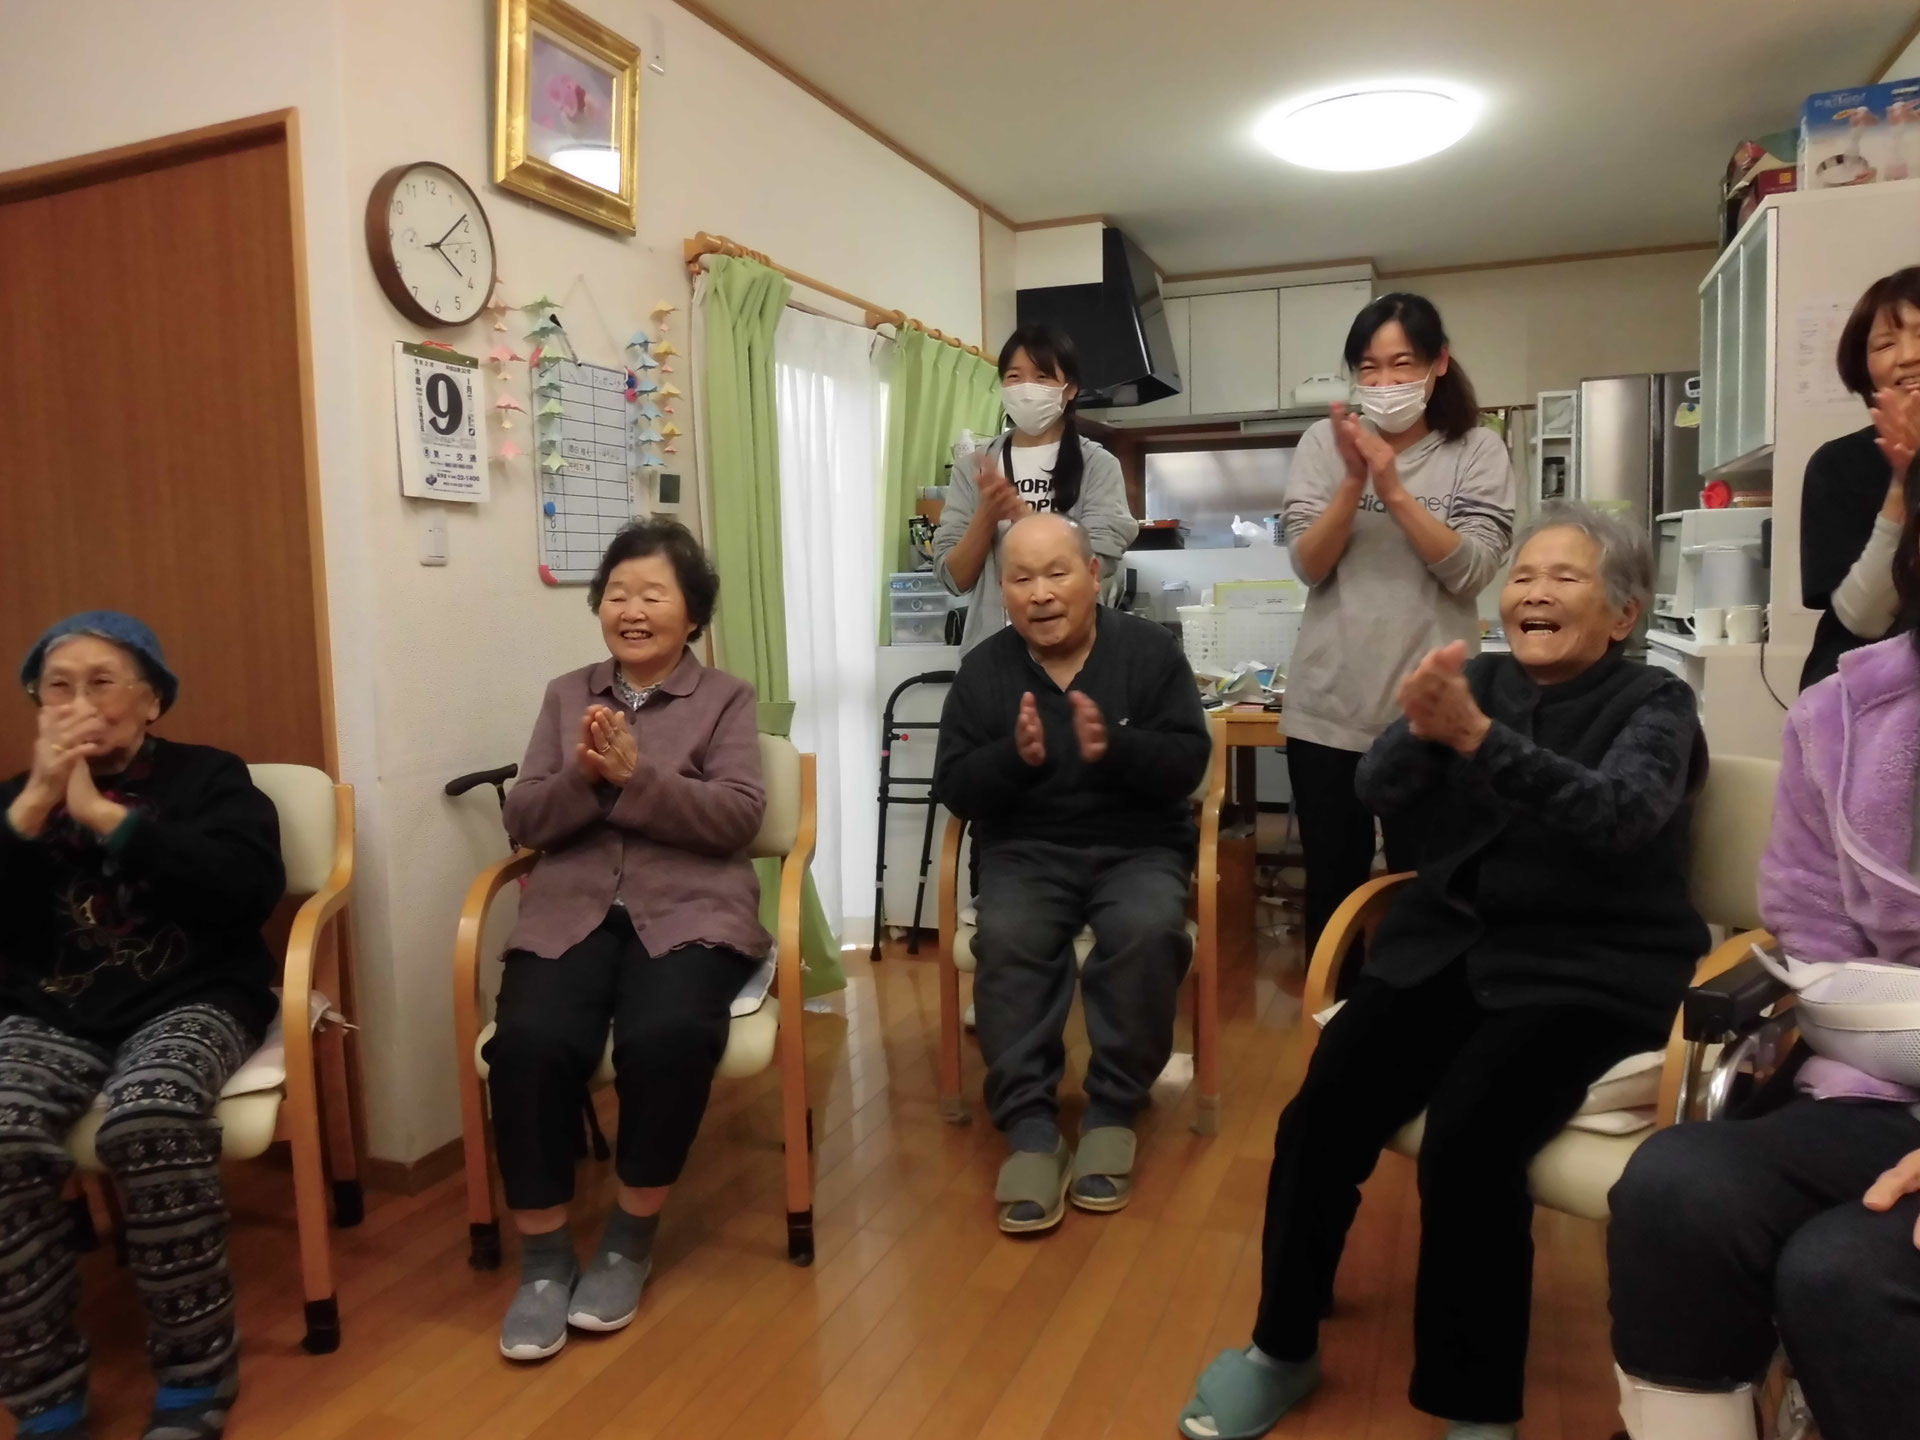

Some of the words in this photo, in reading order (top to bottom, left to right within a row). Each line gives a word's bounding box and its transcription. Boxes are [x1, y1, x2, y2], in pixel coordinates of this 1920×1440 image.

[405, 183, 417, 198] 11
[424, 180, 437, 196] 12
[391, 198, 404, 215] 10
[463, 219, 470, 233] 2
[470, 249, 477, 264] 3
[467, 276, 474, 290] 4
[411, 286, 419, 299] 7
[434, 300, 441, 314] 6
[454, 296, 462, 311] 5
[426, 372, 463, 436] 9
